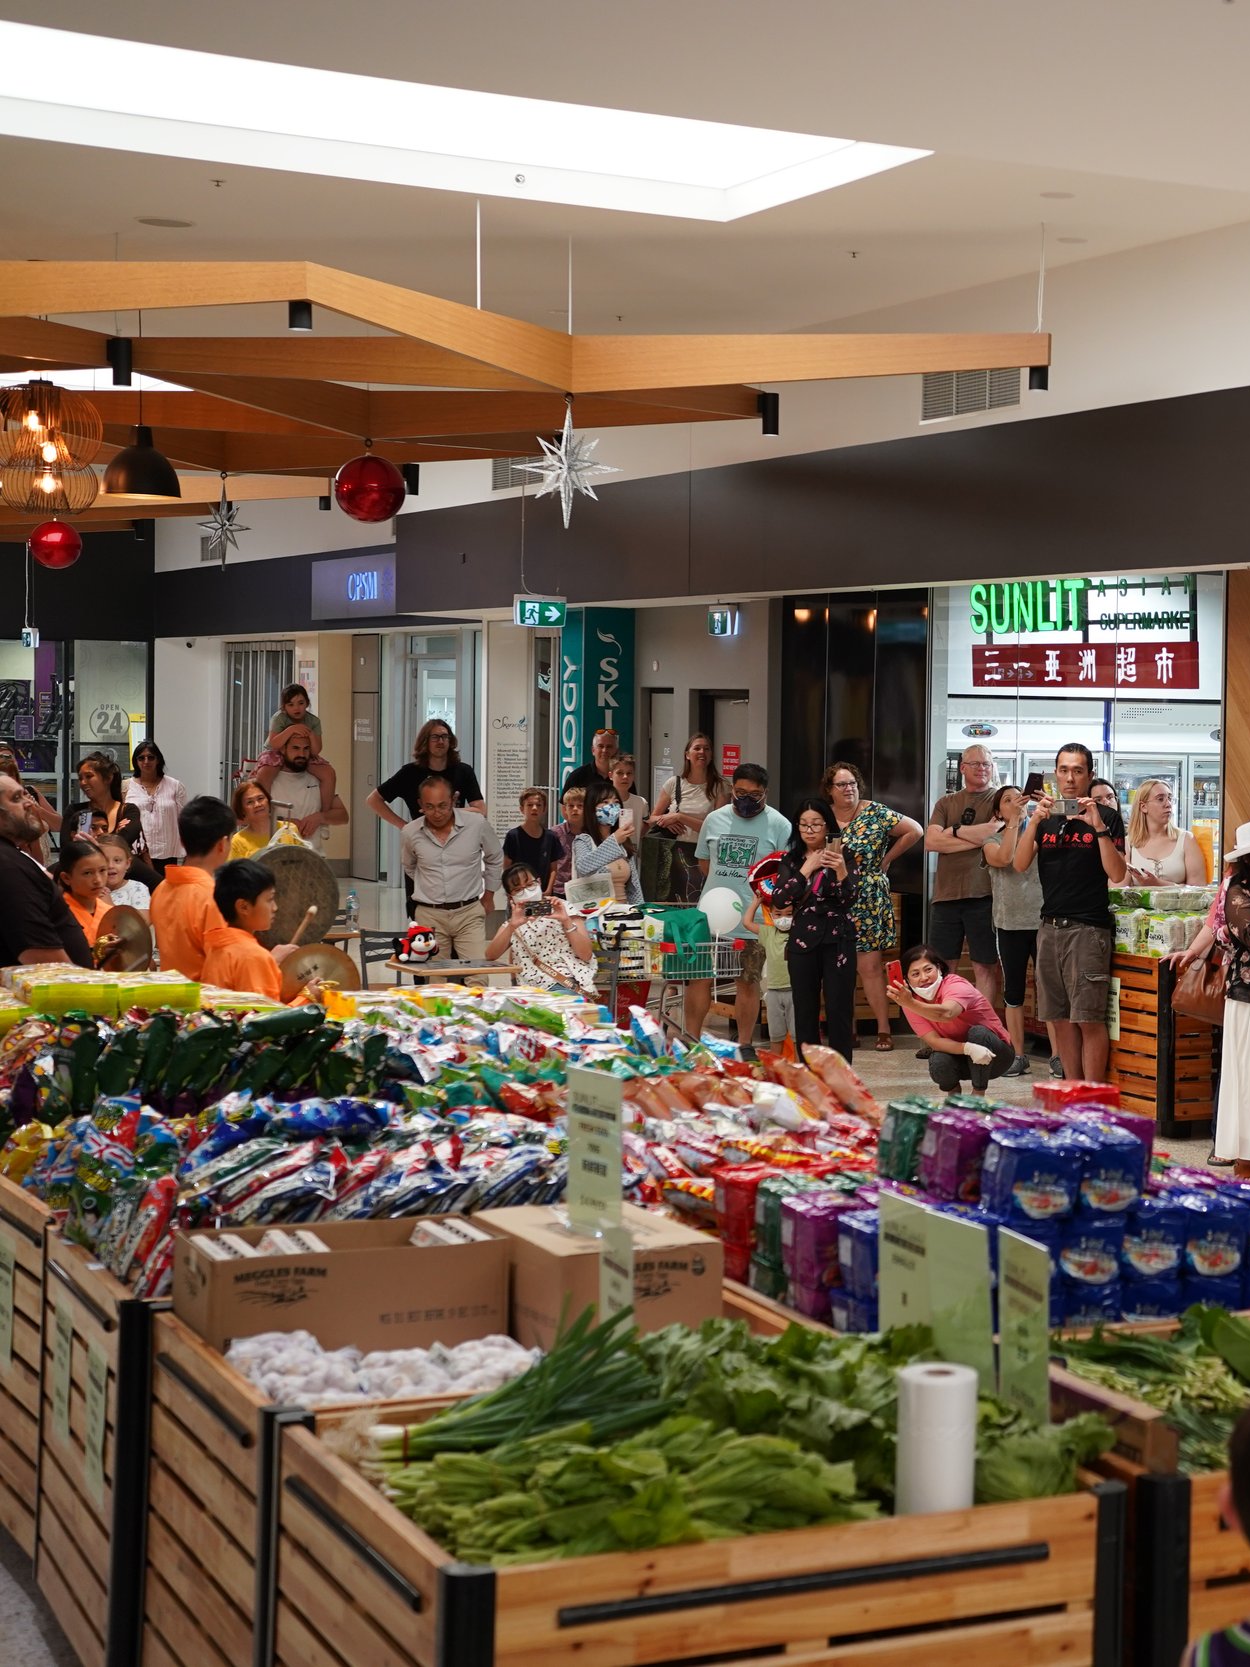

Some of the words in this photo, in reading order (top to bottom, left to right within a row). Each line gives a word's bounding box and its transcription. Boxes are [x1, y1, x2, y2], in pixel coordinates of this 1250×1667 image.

[970, 578, 1086, 634] SUNLIT
[1099, 610, 1197, 631] SUPERMARKET
[597, 657, 620, 731] SKI
[96, 711, 123, 734] 24
[293, 1266, 328, 1278] FARM
